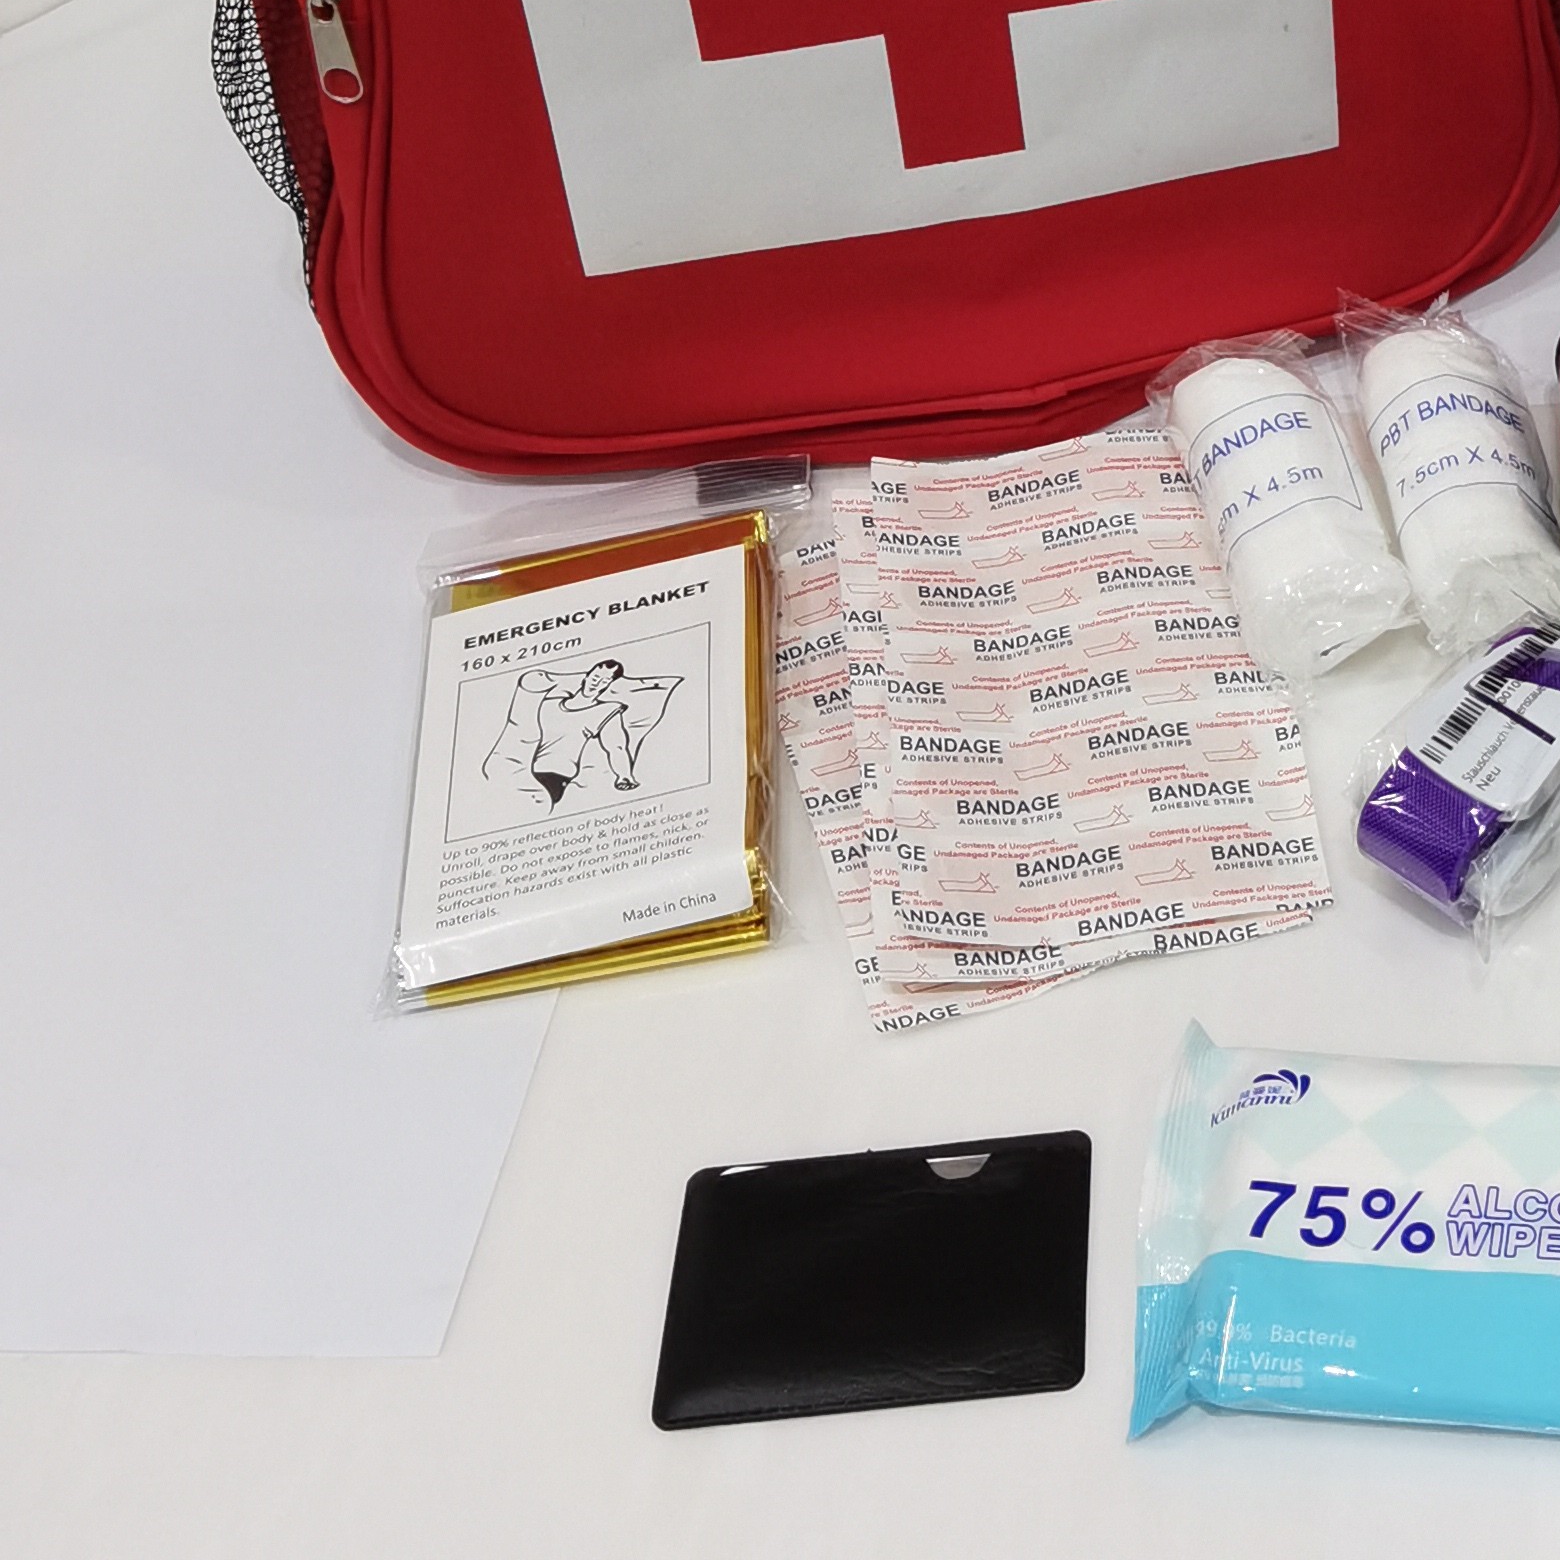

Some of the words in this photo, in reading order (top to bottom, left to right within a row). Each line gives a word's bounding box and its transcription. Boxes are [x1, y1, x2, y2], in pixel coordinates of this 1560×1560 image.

[1380, 410, 1410, 457] PBT
[1417, 393, 1525, 434] BANDAGE
[1202, 411, 1312, 476] BANDAGE
[988, 469, 1080, 502] BANDAGE
[1267, 466, 1323, 492] 4.5m
[1396, 454, 1459, 498] 7.5cm
[1490, 449, 1536, 481] 4.5m
[990, 494, 1042, 511] ADHESIVE
[1046, 484, 1083, 499] STRIPS
[1042, 513, 1136, 543] BANDAGE
[1044, 534, 1097, 552] ADHESIVE
[1101, 527, 1138, 539] STRIPS
[1097, 565, 1193, 584] BANDAGE
[1100, 580, 1154, 594] ADHESIVE
[1158, 579, 1196, 588] STRIPS
[918, 580, 1015, 599] BANDAGE
[920, 599, 975, 608] ADHESIVE
[979, 596, 1017, 608] STRIPS
[463, 607, 600, 649] EMERGENCY
[608, 581, 710, 616] BLANKET
[973, 625, 1072, 653] BANDAGE
[976, 648, 1030, 662] ADHESIVE
[1034, 639, 1074, 653] STRIPS
[461, 654, 495, 672] 160
[517, 636, 581, 661] 210cm
[1029, 669, 1130, 703] BANDAGE
[1032, 693, 1088, 714] ADHESIVE
[1092, 685, 1132, 700] STRIPS
[900, 735, 1001, 755] BANDAGE
[1087, 721, 1190, 751] BANDAGE
[901, 754, 959, 764] ADHESIVE
[963, 755, 1004, 765] STRIPS
[1090, 744, 1147, 761] ADHESIVE
[1152, 739, 1192, 751] STRIPS
[1462, 730, 1509, 784] Stauschlauch
[1149, 779, 1251, 802] BANDAGE
[1475, 766, 1502, 792] Neu
[956, 793, 1061, 815] BANDAGE
[1151, 798, 1209, 813] ADHESIVE
[1213, 796, 1254, 807] STRIPS
[959, 817, 1017, 826] ADHESIVE
[1022, 811, 1062, 825] STRIPS
[441, 858, 483, 874] Unroll,
[488, 849, 525, 864] drape
[529, 842, 558, 854] over
[562, 835, 594, 847] body
[597, 830, 607, 839] &
[611, 823, 640, 836] hold
[643, 820, 657, 829] as
[660, 811, 692, 825] close
[696, 807, 709, 816] as
[443, 850, 461, 860] Up
[465, 847, 478, 856] to
[482, 840, 509, 852] 90%
[513, 825, 573, 846] reflection
[577, 821, 591, 831] of
[594, 814, 625, 827] body
[500, 863, 518, 874] Do
[521, 856, 544, 869] not
[547, 847, 592, 864] expose
[596, 843, 609, 852] to
[695, 819, 709, 829] or
[1210, 836, 1315, 861] BANDAGE
[505, 871, 537, 886] Keep
[541, 863, 574, 877] away
[578, 855, 608, 868] from
[613, 843, 646, 859] small
[1016, 844, 1122, 878] BANDAGE
[1215, 859, 1273, 872] ADHESIVE
[1278, 853, 1319, 866] STRIPS
[437, 890, 510, 914] Suffocation
[513, 877, 563, 896] hazards
[567, 870, 597, 883] exist
[600, 861, 629, 876] with
[633, 856, 647, 868] all
[651, 846, 693, 865] plastic
[1018, 872, 1077, 888] ADHESIVE
[1082, 862, 1124, 877] STRIPS
[622, 905, 660, 923] Made
[664, 901, 676, 913] in
[679, 892, 717, 909] China
[1078, 902, 1185, 936] BANDAGE
[1154, 923, 1259, 951] BANDAGE
[954, 945, 1062, 968] BANDAGE
[958, 965, 1018, 976] ADHESIVE
[1023, 959, 1065, 973] STRIPS
[1246, 1180, 1435, 1255] 75%
[1270, 1324, 1357, 1349] Bacteria
